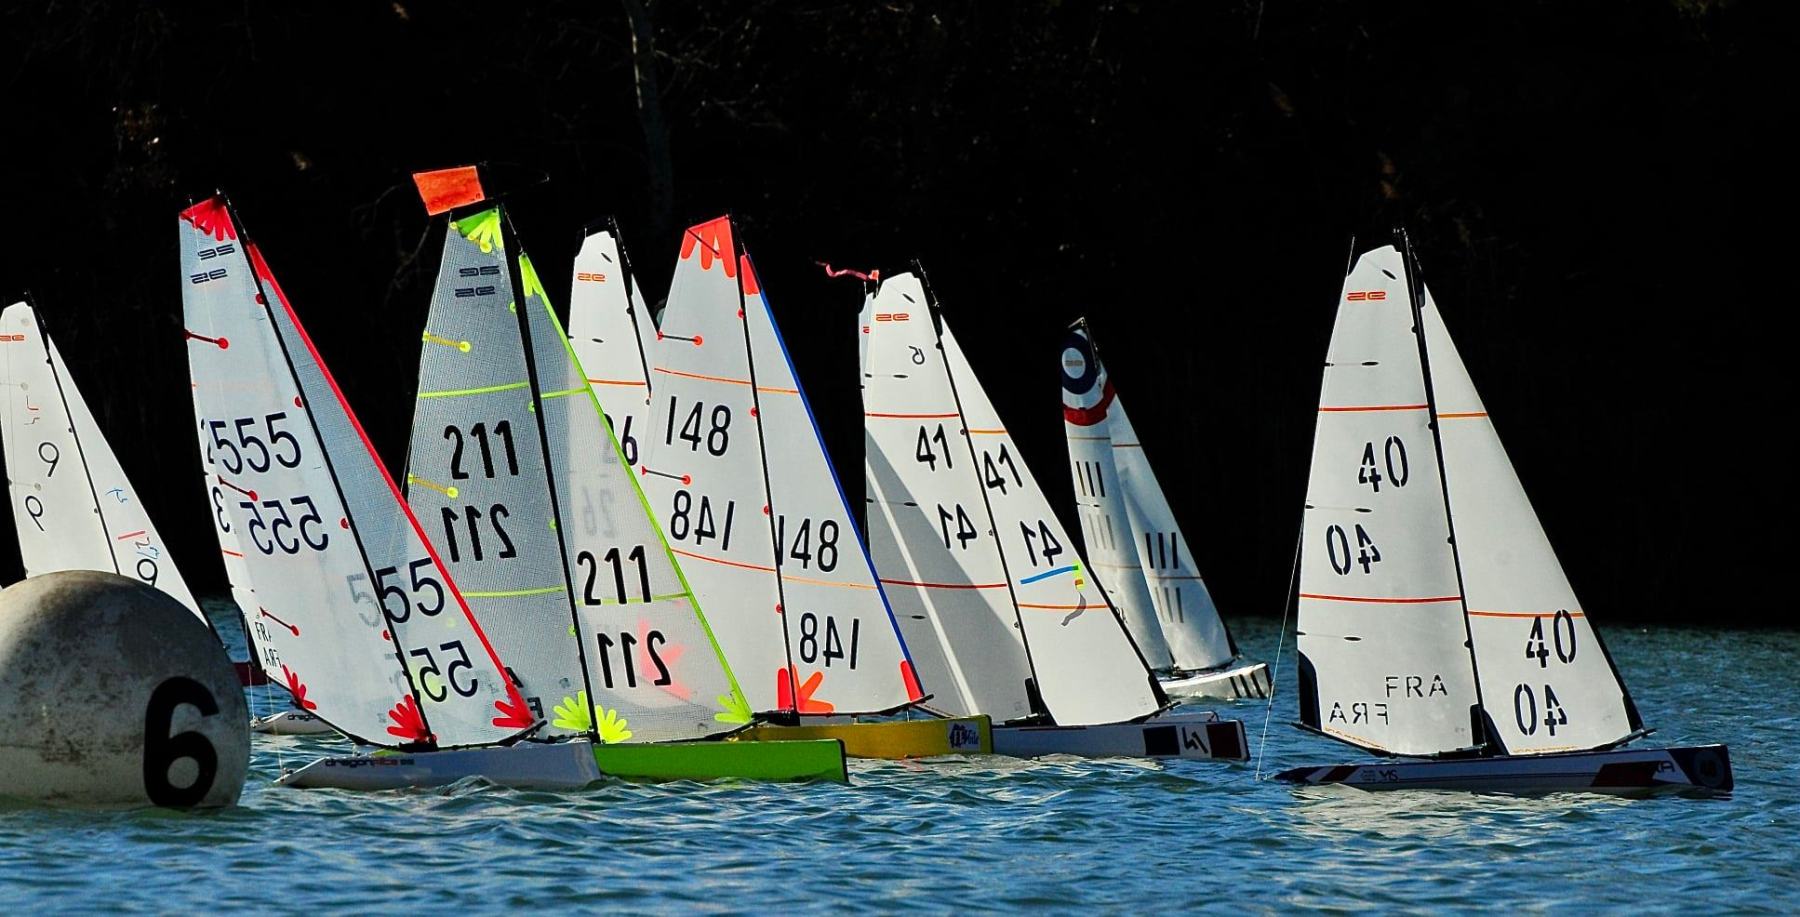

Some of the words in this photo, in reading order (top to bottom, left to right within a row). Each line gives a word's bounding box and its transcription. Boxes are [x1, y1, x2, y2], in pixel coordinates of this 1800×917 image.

[209, 412, 301, 475] 555
[443, 420, 519, 480] 211
[666, 396, 731, 456] 148
[916, 423, 953, 471] 41
[38, 442, 59, 477] 9
[984, 443, 1023, 495] 41
[1358, 435, 1408, 492] 40
[777, 515, 839, 572] 148
[577, 545, 651, 605] 211
[1526, 610, 1577, 668] 40
[1385, 674, 1447, 698] FRA
[143, 676, 219, 806] 6
